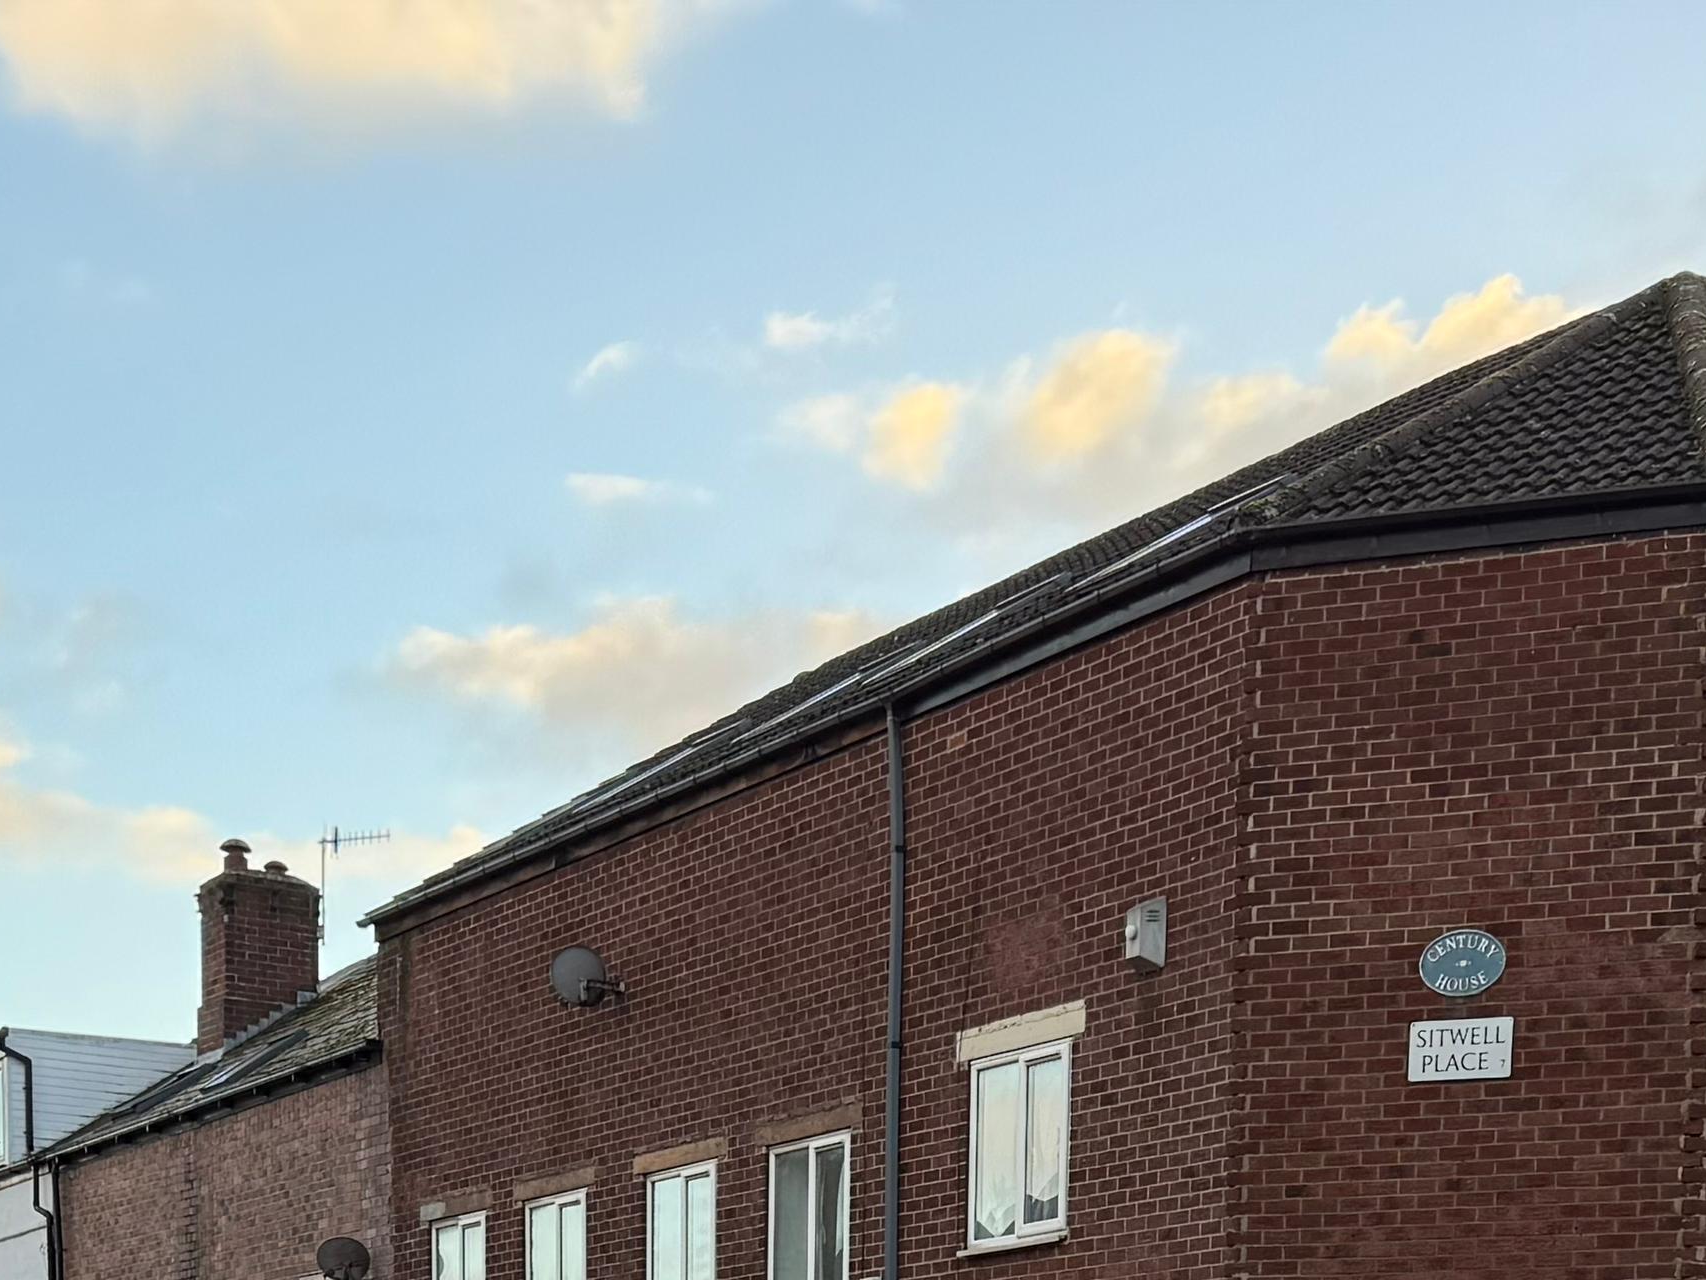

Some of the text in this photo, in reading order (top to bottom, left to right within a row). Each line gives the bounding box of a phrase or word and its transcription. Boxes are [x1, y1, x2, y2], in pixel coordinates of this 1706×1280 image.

[1427, 934, 1499, 962] CENTURY
[1435, 970, 1488, 991] HOUSE
[1416, 1025, 1505, 1047] SITWELL
[1422, 1052, 1506, 1073] PLACE 7
